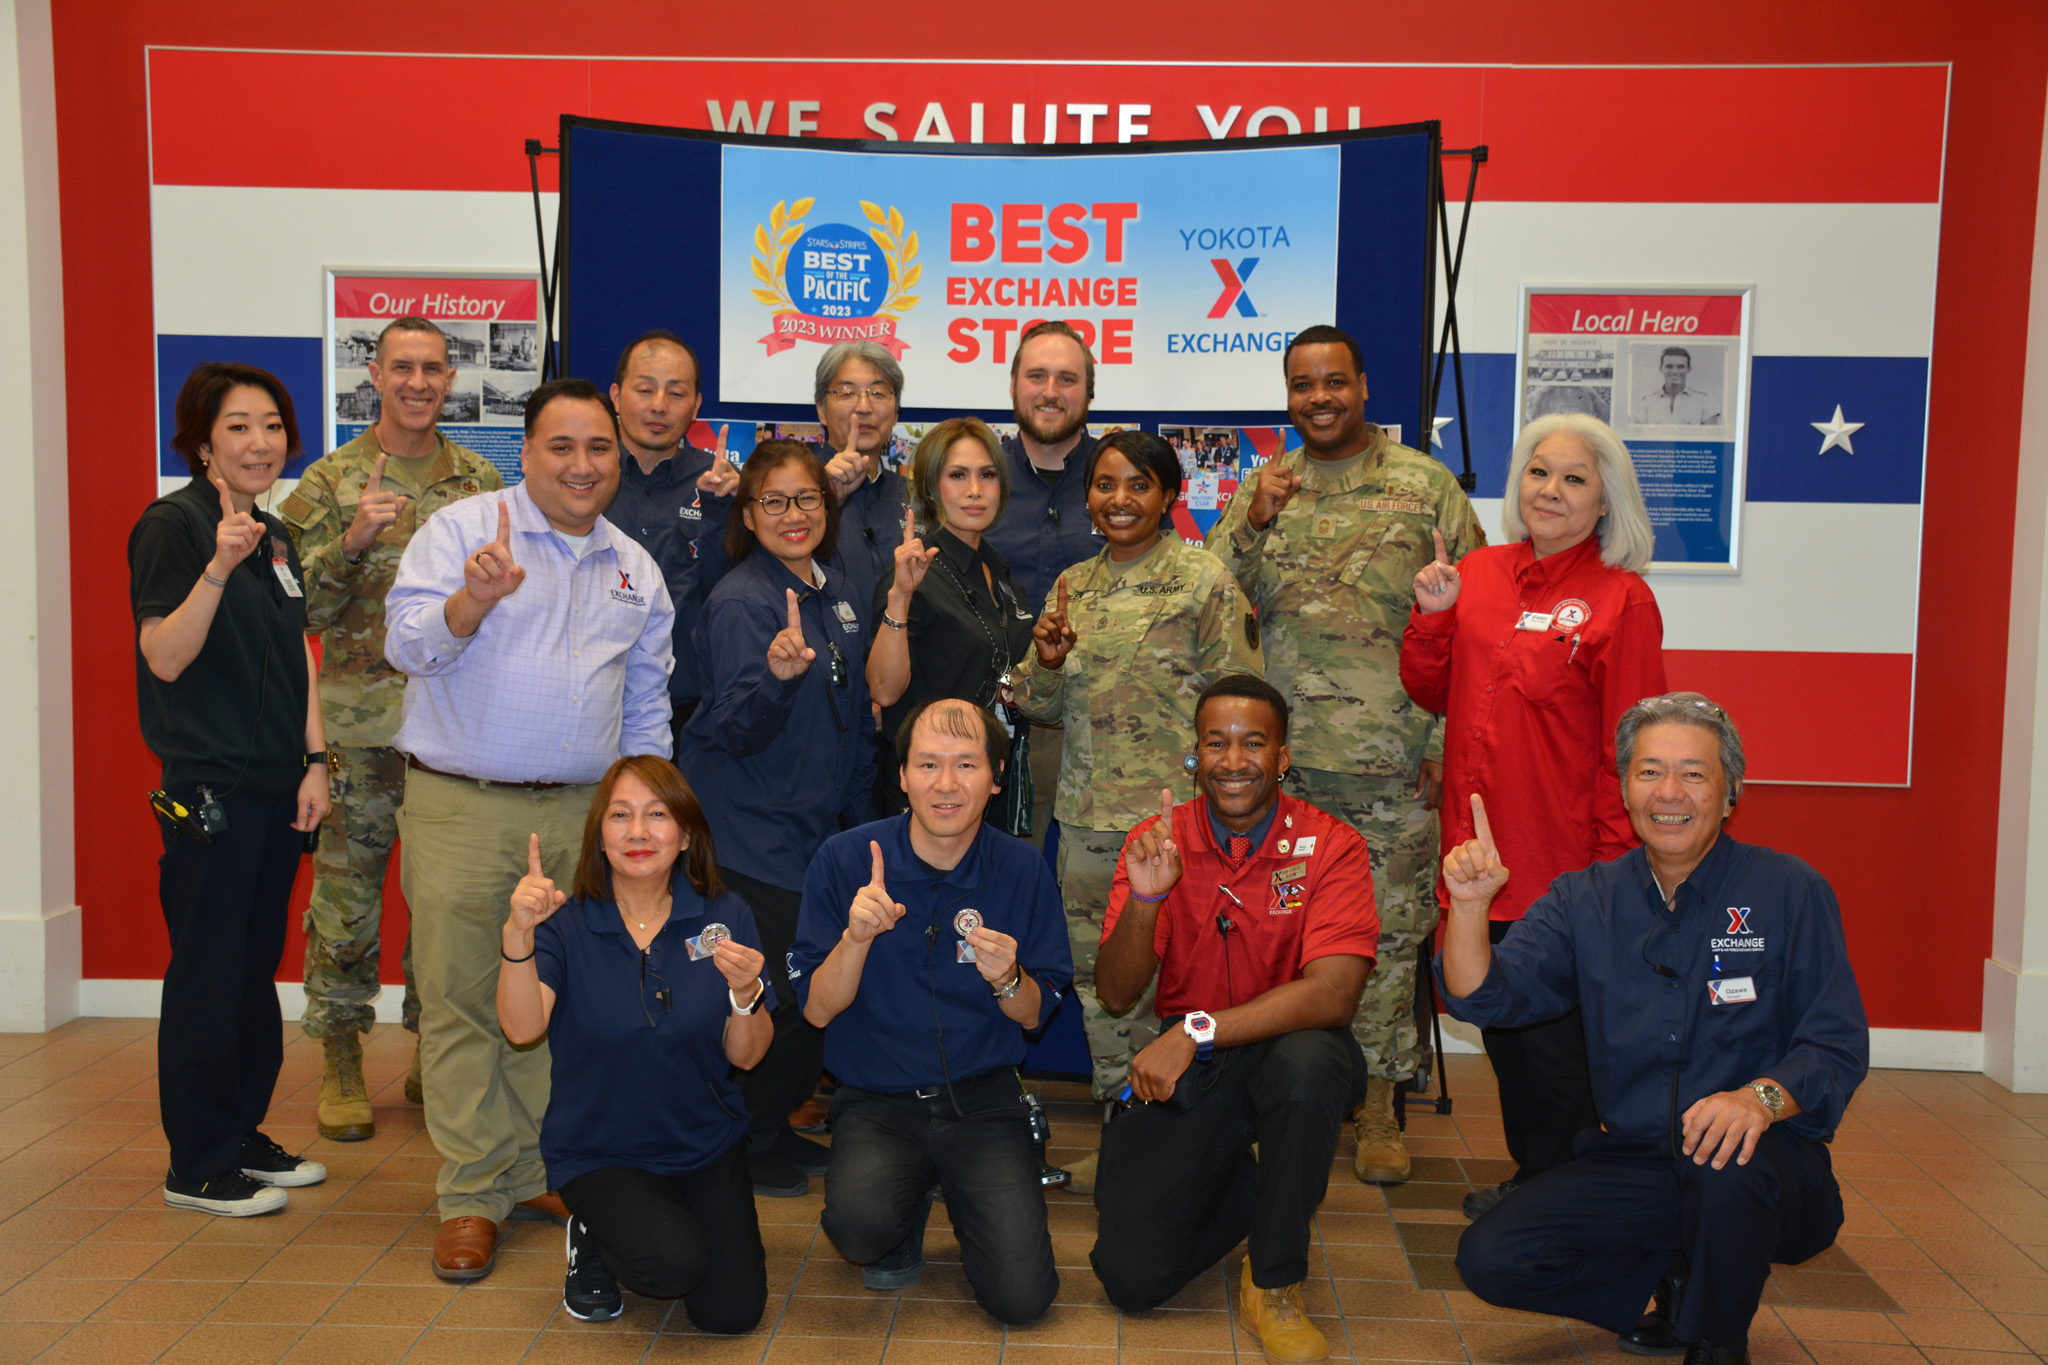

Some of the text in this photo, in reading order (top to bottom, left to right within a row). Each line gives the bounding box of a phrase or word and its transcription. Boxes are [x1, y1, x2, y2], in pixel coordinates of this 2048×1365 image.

[706, 99, 820, 137] WE
[864, 102, 1151, 144] SALUTE
[807, 237, 868, 250] STARS STRIPES
[950, 202, 1138, 264] BEST
[1179, 225, 1290, 251] YOKOTA
[803, 250, 871, 272] BEST
[826, 271, 848, 280] OF THE
[803, 274, 871, 302] PACIFIC
[946, 276, 1138, 307] EXCHANGE
[369, 292, 506, 322] Our History
[822, 304, 852, 317] 2023
[779, 319, 892, 340] 2023 WINNER
[1571, 308, 1699, 333] Local Hero
[1360, 500, 1420, 512] US AIR FORCE
[610, 589, 646, 604] EXCHANGE
[1140, 582, 1186, 595] U.S. ARMY
[1285, 872, 1297, 880] SON
[1711, 937, 1765, 948] EXCHANGE
